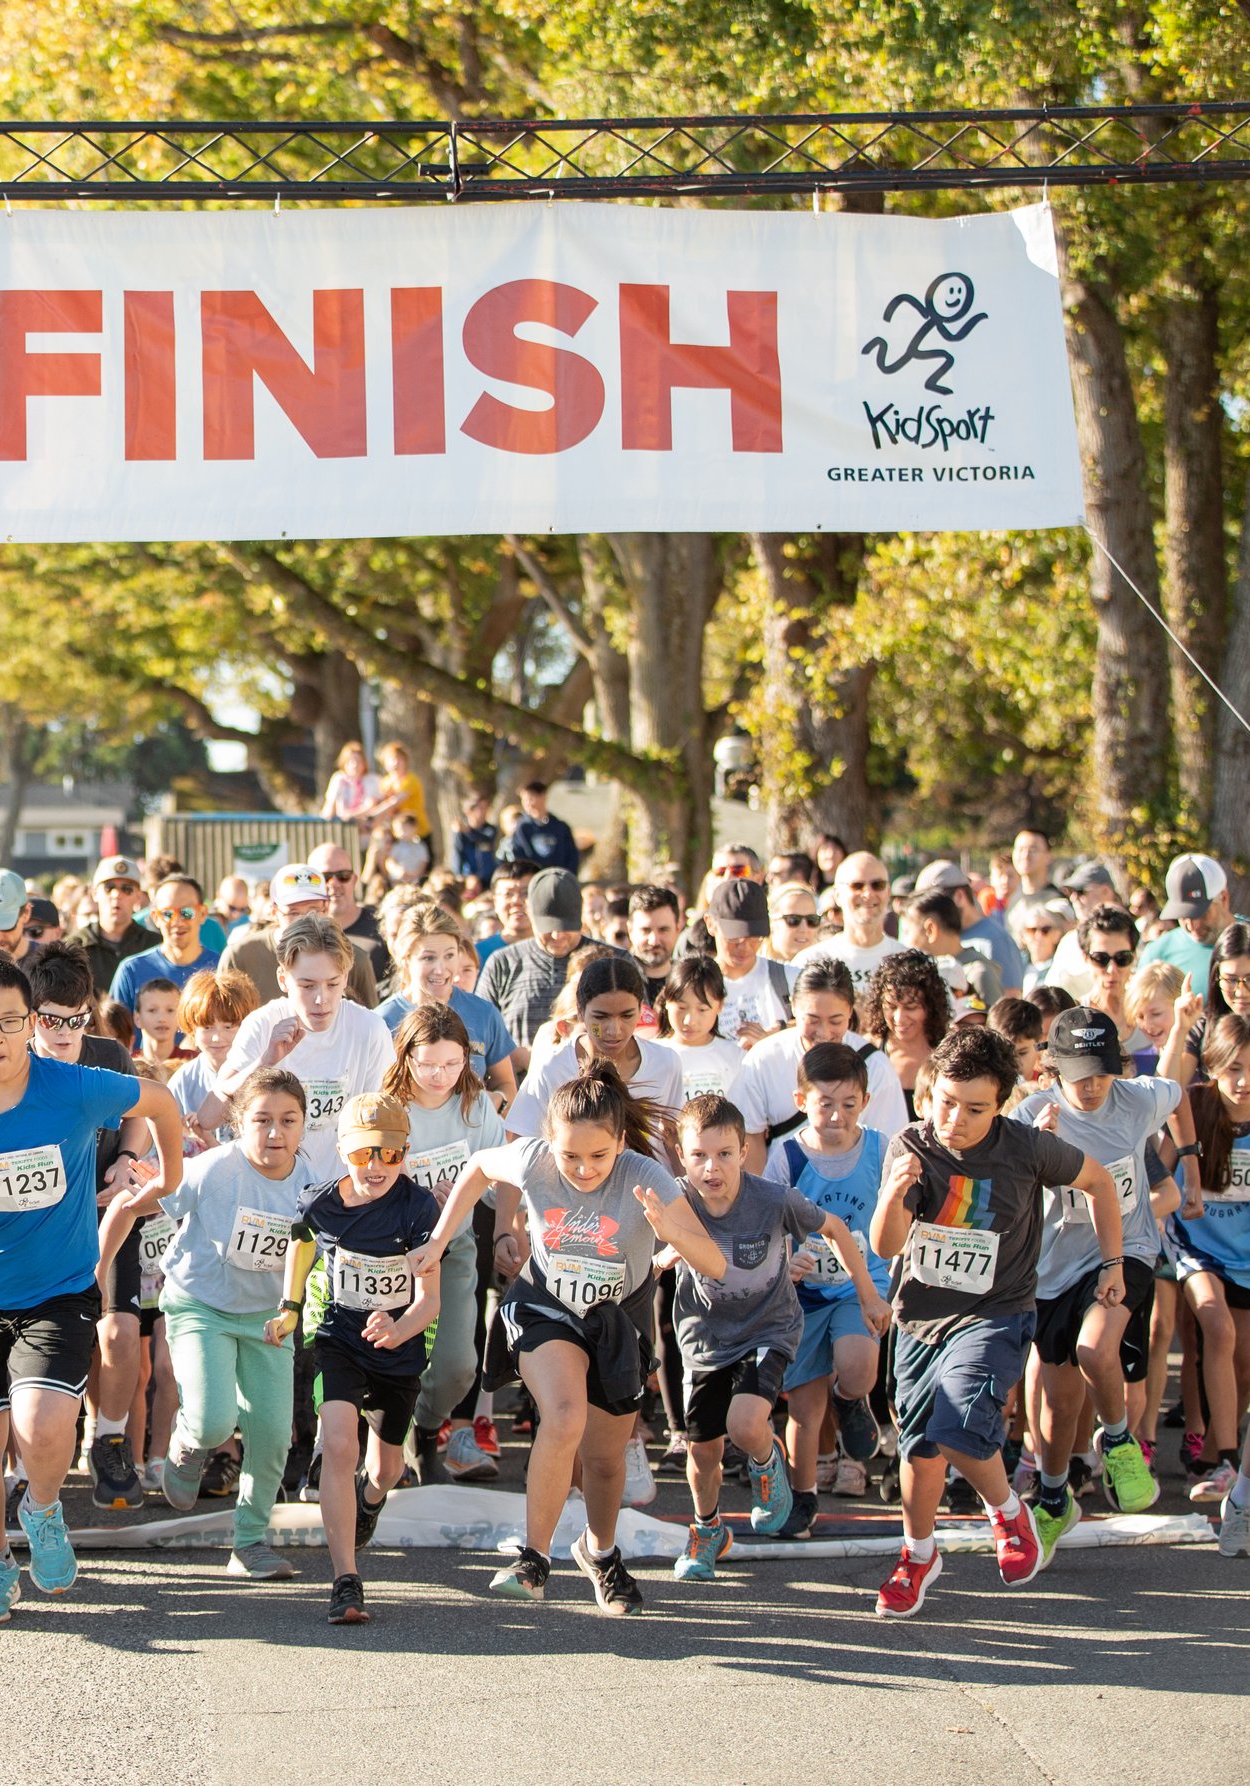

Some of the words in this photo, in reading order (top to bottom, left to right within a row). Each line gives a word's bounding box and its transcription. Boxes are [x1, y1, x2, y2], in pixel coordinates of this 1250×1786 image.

[862, 401, 995, 452] KidSport
[827, 467, 924, 482] GREATER
[932, 465, 1036, 482] VICTORIA
[17, 1163, 36, 1171] Kids
[37, 1160, 54, 1168] Run
[952, 1241, 971, 1249] Kids
[972, 1243, 990, 1251] Run
[919, 1245, 992, 1275] 11477
[339, 1269, 407, 1296] 11332
[586, 1273, 607, 1282] Kids
[554, 1277, 624, 1305] 11096
